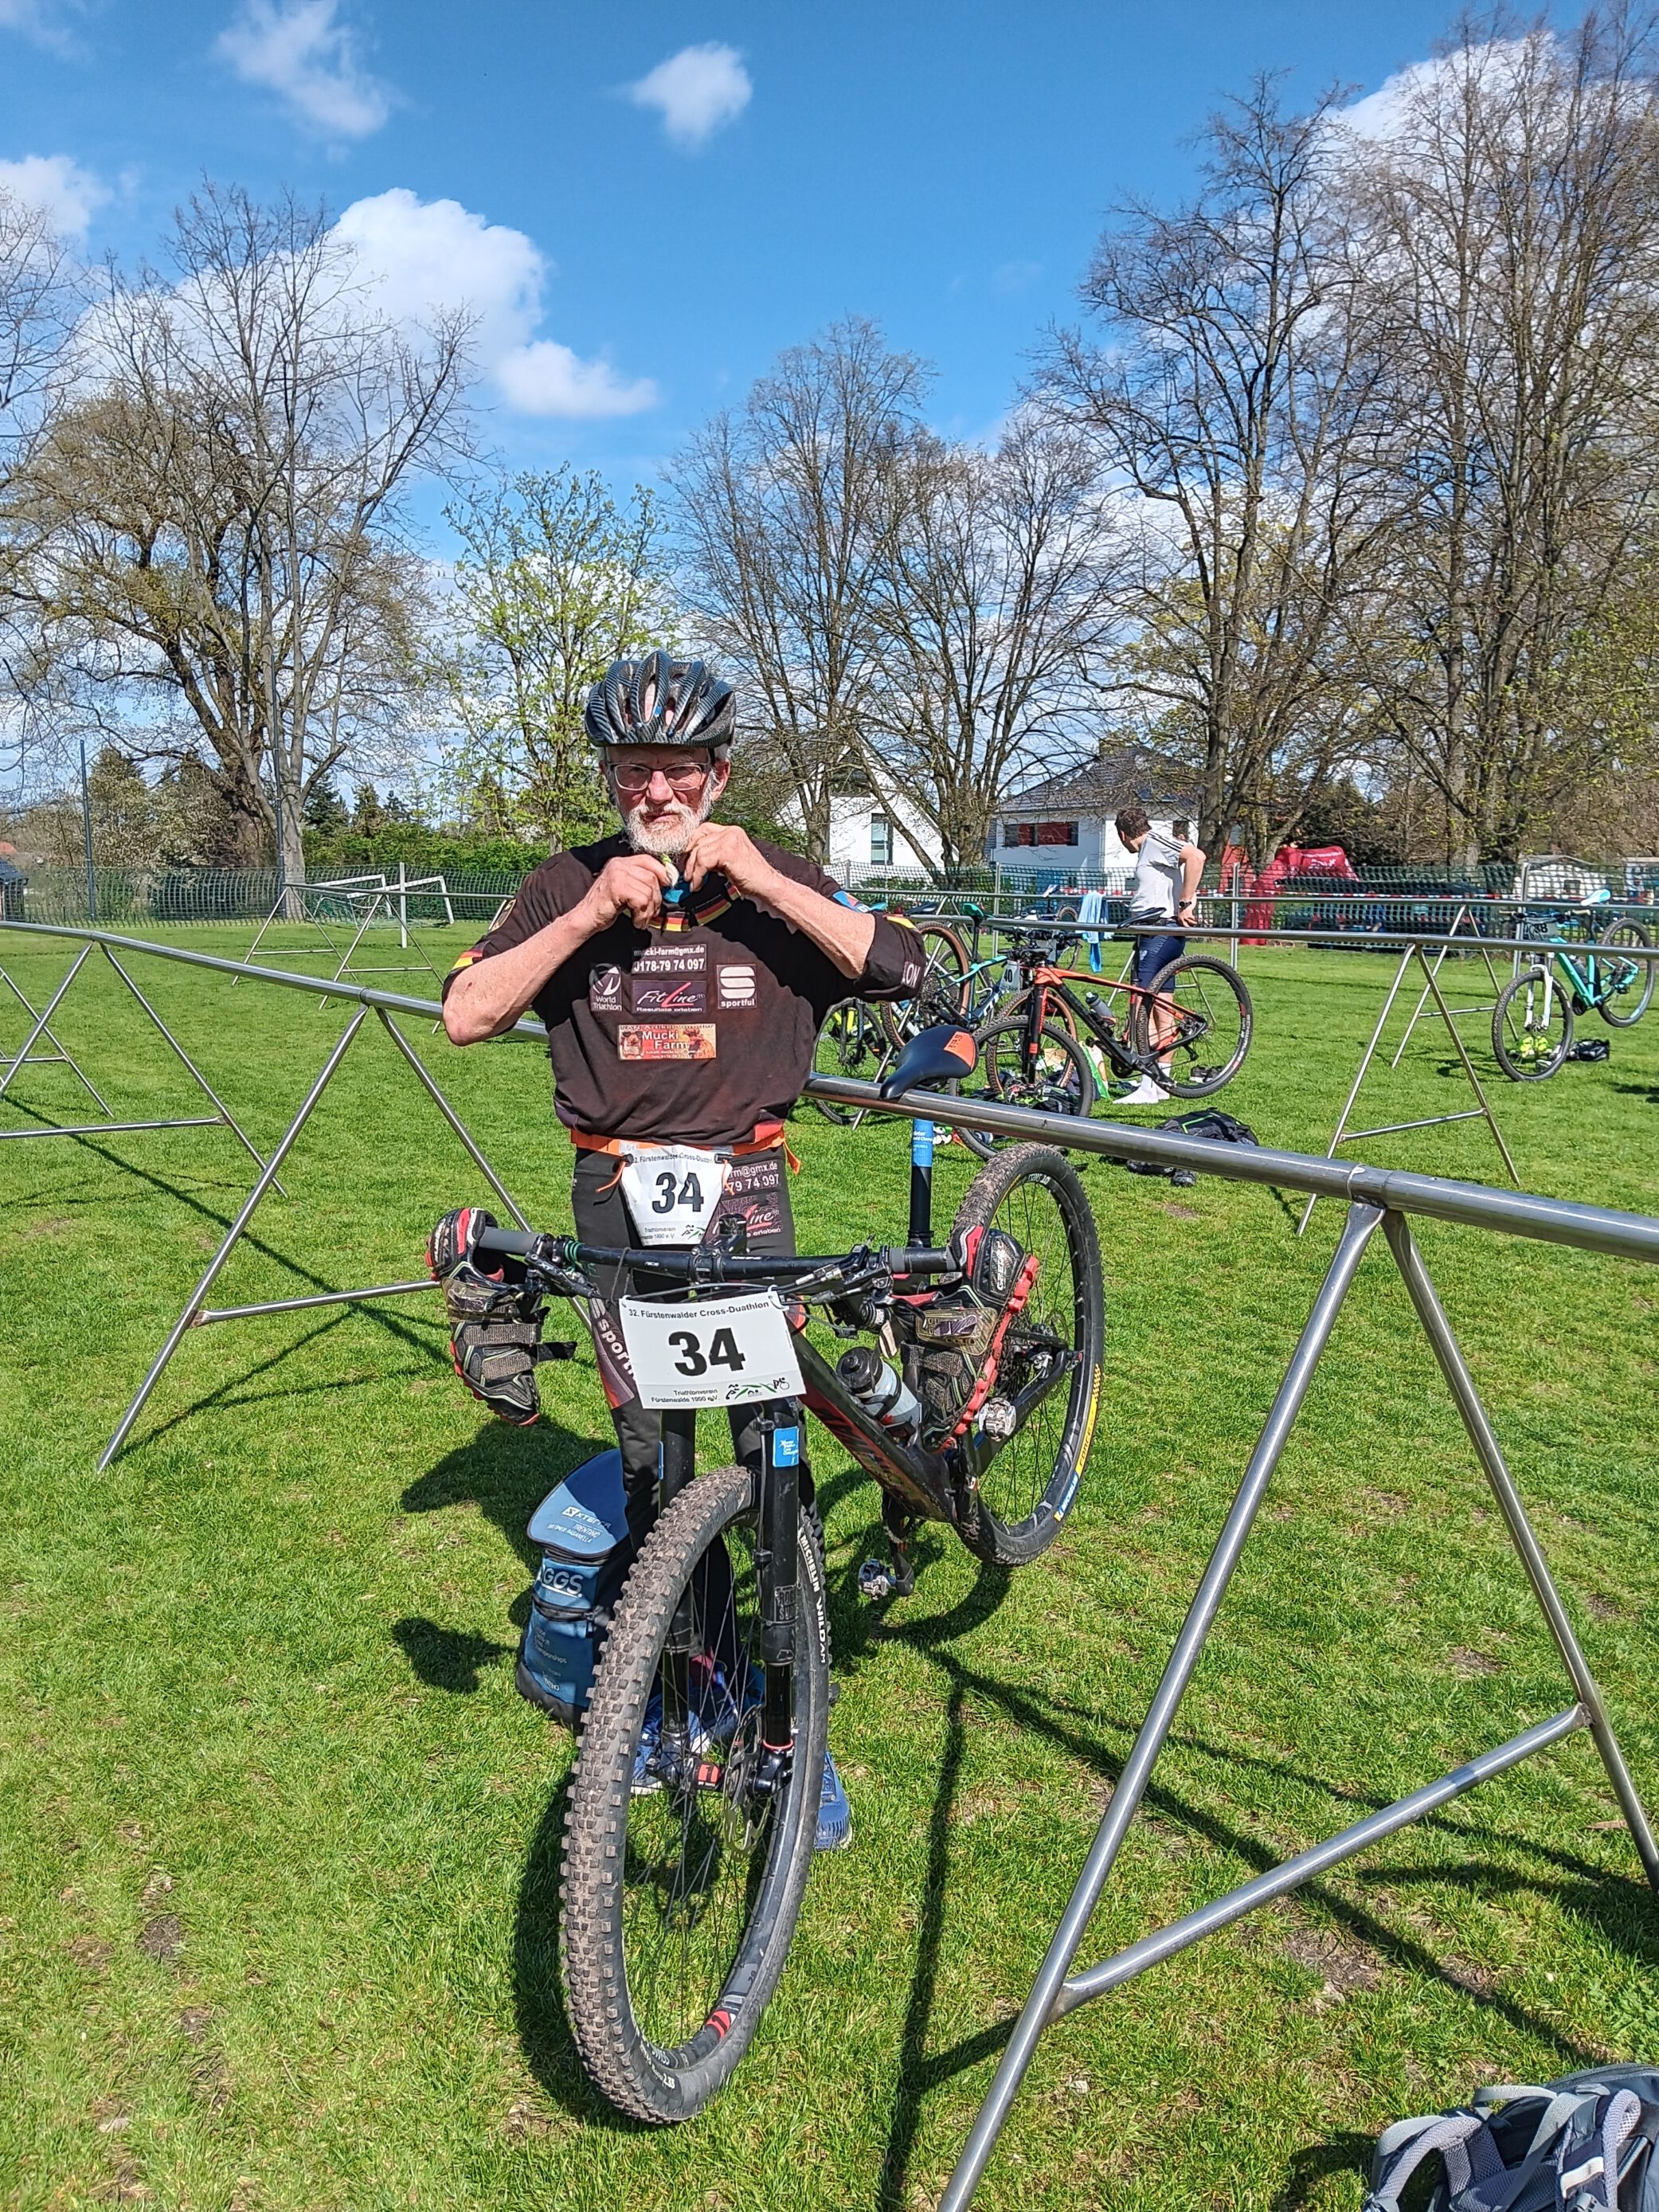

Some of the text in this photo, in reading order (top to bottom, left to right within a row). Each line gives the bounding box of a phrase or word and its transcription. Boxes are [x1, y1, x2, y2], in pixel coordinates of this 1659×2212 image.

[673, 959, 686, 971] 74
[687, 958, 705, 970] 097
[1004, 969, 1013, 983] 40
[720, 999, 756, 1008] sportful
[642, 1031, 679, 1040] Mucki
[655, 1040, 690, 1050] Farm
[745, 1176, 761, 1189] 74
[762, 1173, 779, 1187] 097
[651, 1172, 705, 1215] 34
[628, 1302, 770, 1319] 32. Fürstenwalder Cross-Duathlon
[599, 1318, 635, 1376] sport
[668, 1327, 746, 1376] 34
[800, 1534, 820, 1592] MICHELIN
